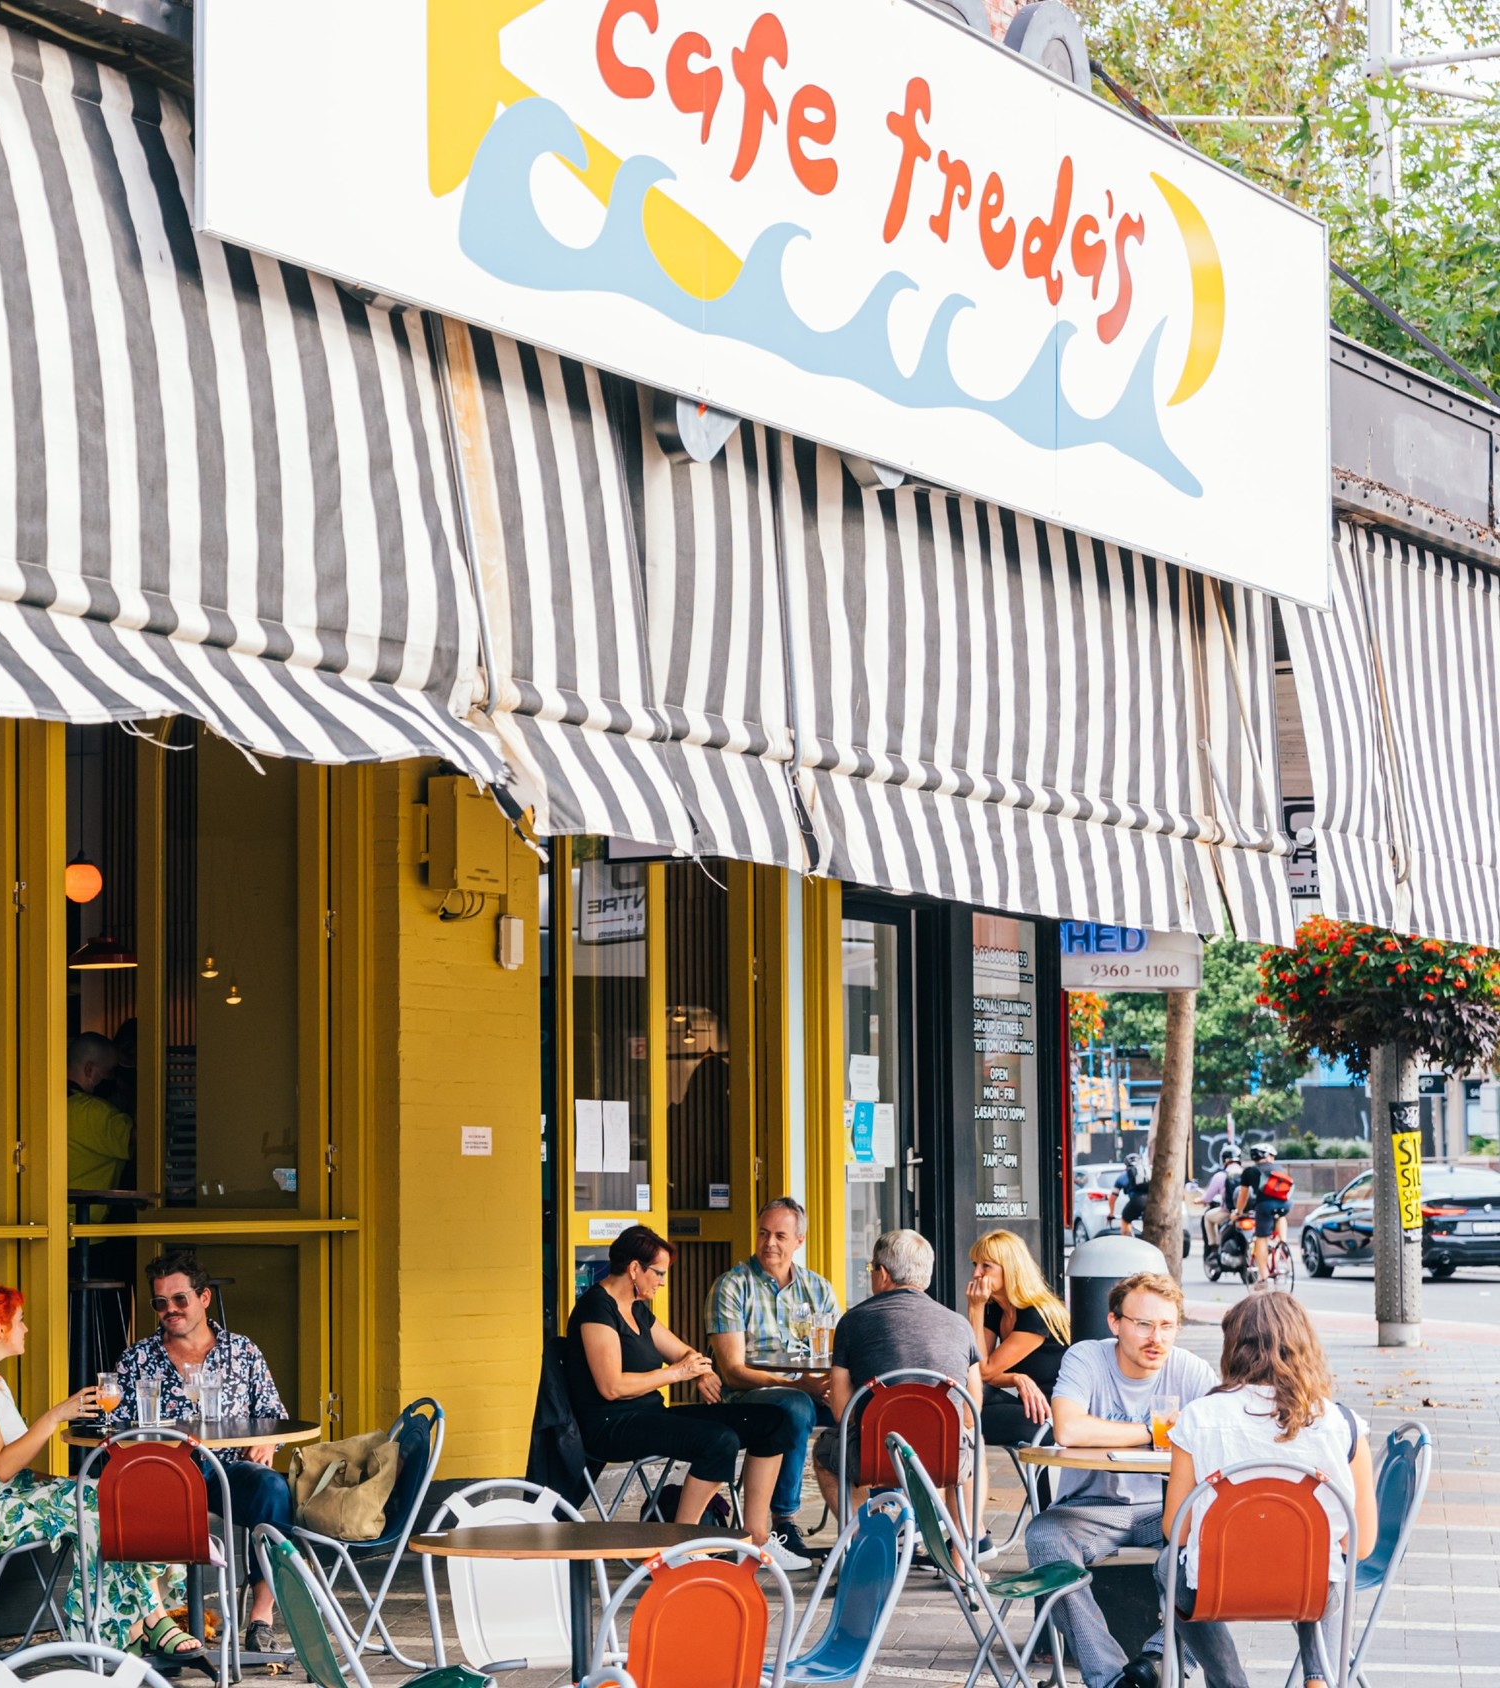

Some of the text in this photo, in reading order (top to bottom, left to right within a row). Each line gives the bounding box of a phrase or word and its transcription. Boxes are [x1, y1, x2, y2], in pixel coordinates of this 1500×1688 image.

[1090, 964, 1130, 977] 9360
[1145, 964, 1180, 978] 1100
[1000, 1000, 1031, 1017] TRAINING
[996, 1021, 1024, 1036] FITNESS
[999, 1040, 1034, 1054] COACHING
[990, 1067, 1008, 1081] OPEN
[983, 1087, 999, 1100] MON
[1004, 1087, 1015, 1101] FRI
[998, 1106, 1008, 1120] TO
[1008, 1107, 1026, 1121] 10PM
[993, 1136, 1007, 1149] SAT
[983, 1154, 998, 1168] 7AM
[1003, 1154, 1018, 1168] 4PM
[993, 1185, 1008, 1199] SUN
[1009, 1202, 1028, 1216] ONLY
